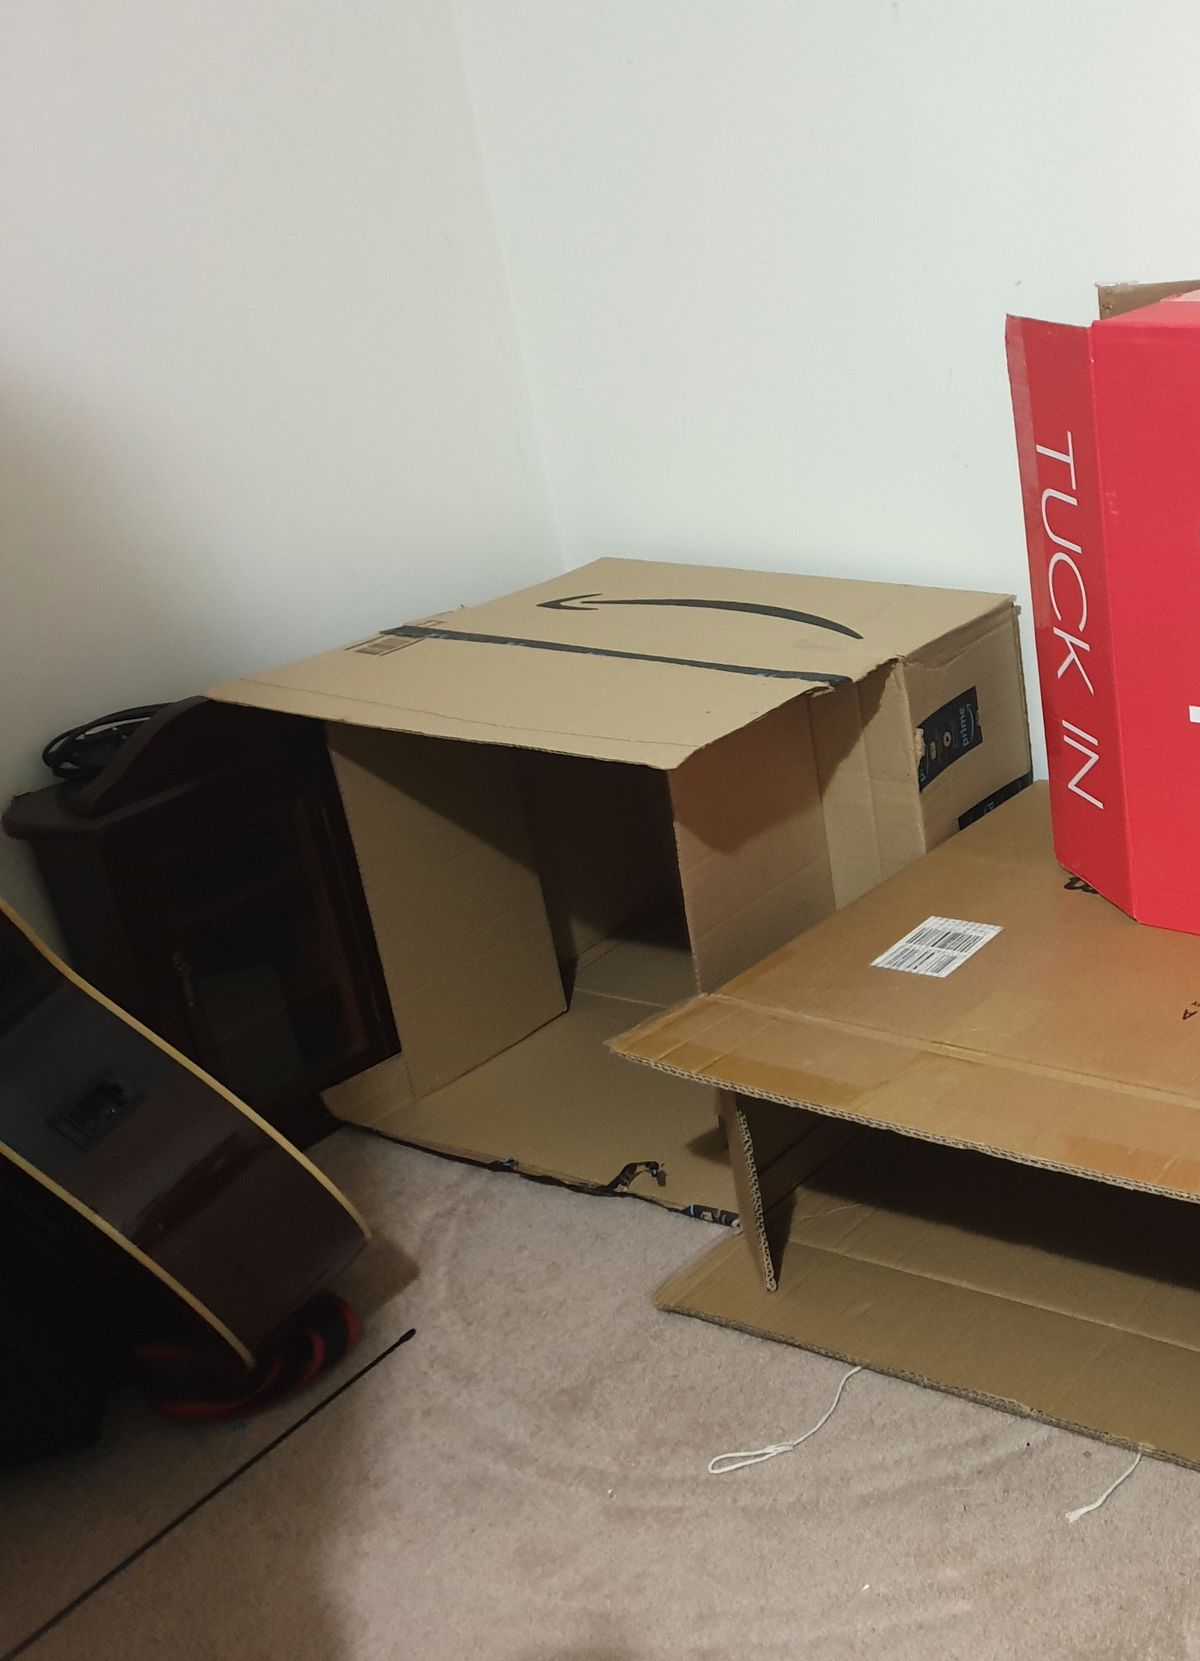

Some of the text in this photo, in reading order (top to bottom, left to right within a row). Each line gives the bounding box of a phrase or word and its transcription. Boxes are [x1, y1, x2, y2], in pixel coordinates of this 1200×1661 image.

[1035, 431, 1104, 809] TUCK IN
[959, 706, 971, 748] prime
